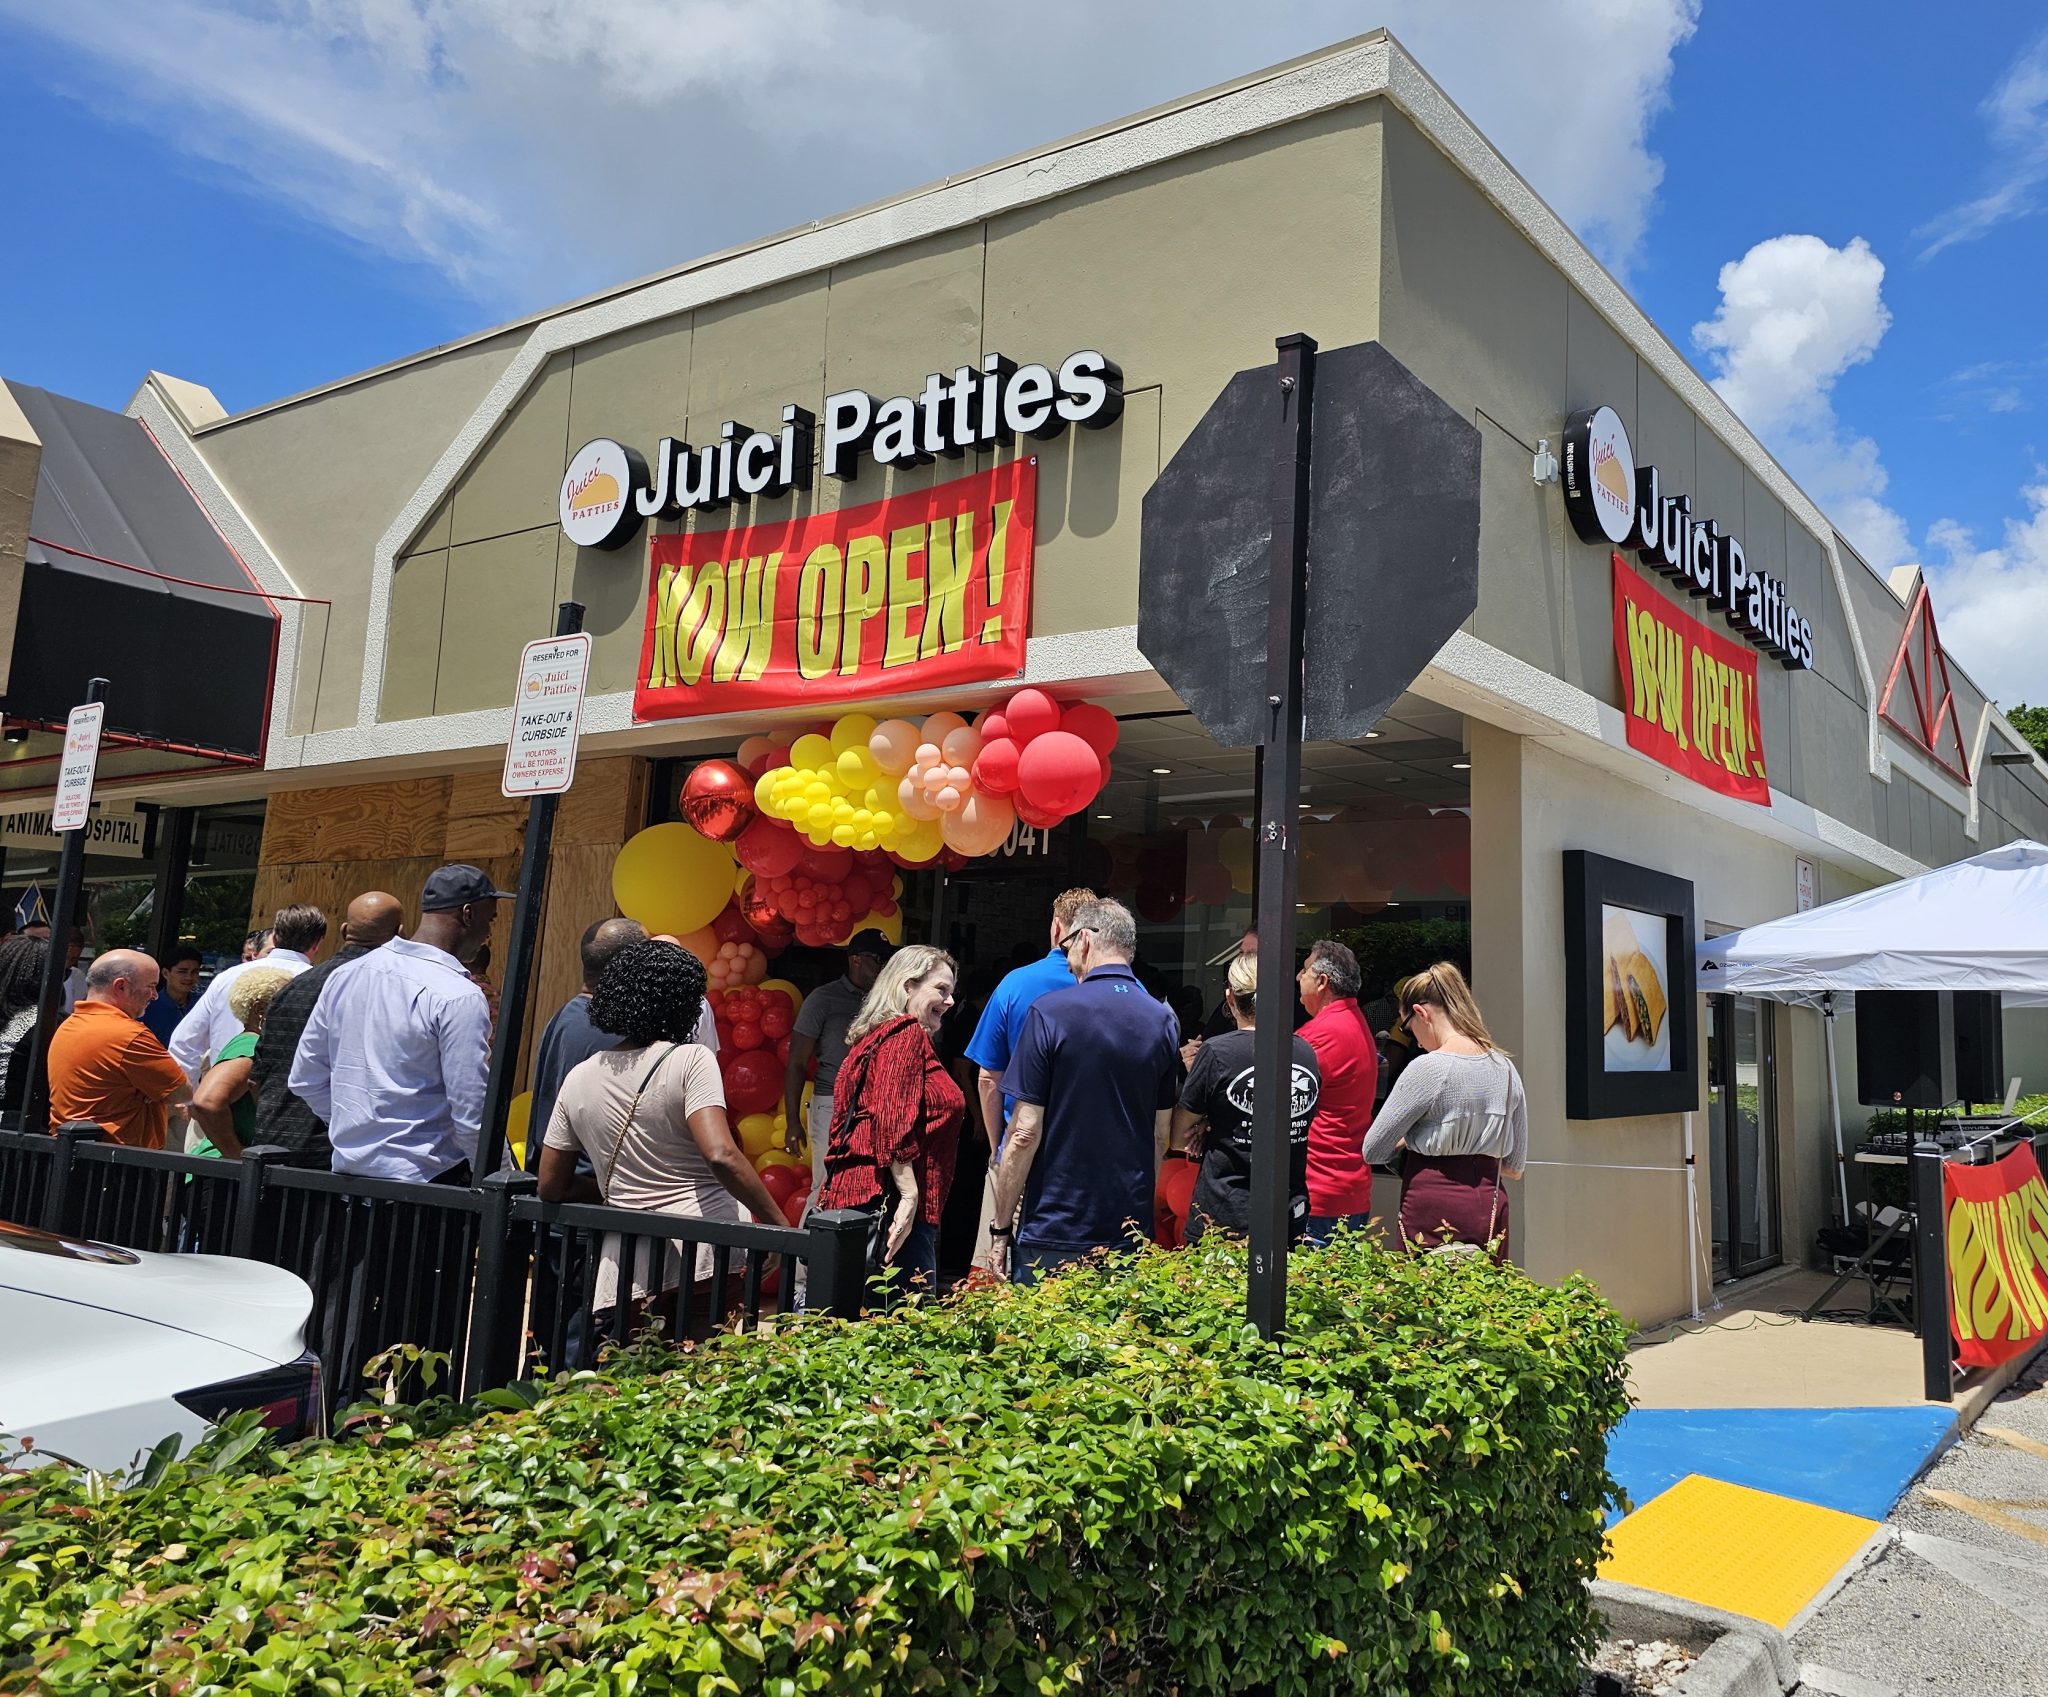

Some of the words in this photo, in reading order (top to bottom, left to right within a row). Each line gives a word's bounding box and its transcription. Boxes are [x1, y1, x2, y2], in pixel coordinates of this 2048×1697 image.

[636, 404, 799, 517] Juici
[824, 350, 1107, 476] Patties
[1593, 434, 1615, 476] Juici
[567, 457, 601, 510] Juici
[572, 501, 620, 520] PATTIES
[1597, 483, 1629, 515] PATTIES
[1641, 466, 1720, 598] Juici
[1730, 536, 1814, 669] Patties
[647, 550, 785, 690] NOW
[796, 499, 1013, 680] OPEN!
[532, 651, 564, 662] RESERVED
[565, 649, 579, 658] FOR
[544, 670, 569, 683] Juici
[543, 684, 577, 697] Patties
[521, 712, 566, 727] TAKE-OUT
[566, 711, 573, 722] &
[1691, 645, 1766, 778] OPEN!
[522, 726, 567, 742] CURBSIDE
[513, 759, 526, 769] WILL
[527, 758, 536, 768] BE
[536, 757, 557, 767] TOWED
[558, 757, 566, 765] AT
[525, 748, 557, 758] VIOLATORS
[512, 769, 537, 779] OWNERS
[538, 767, 564, 777] EXPENSE
[6, 812, 61, 838] ANIMA
[84, 817, 140, 845] OSPITAL
[988, 814, 1049, 858] 041
